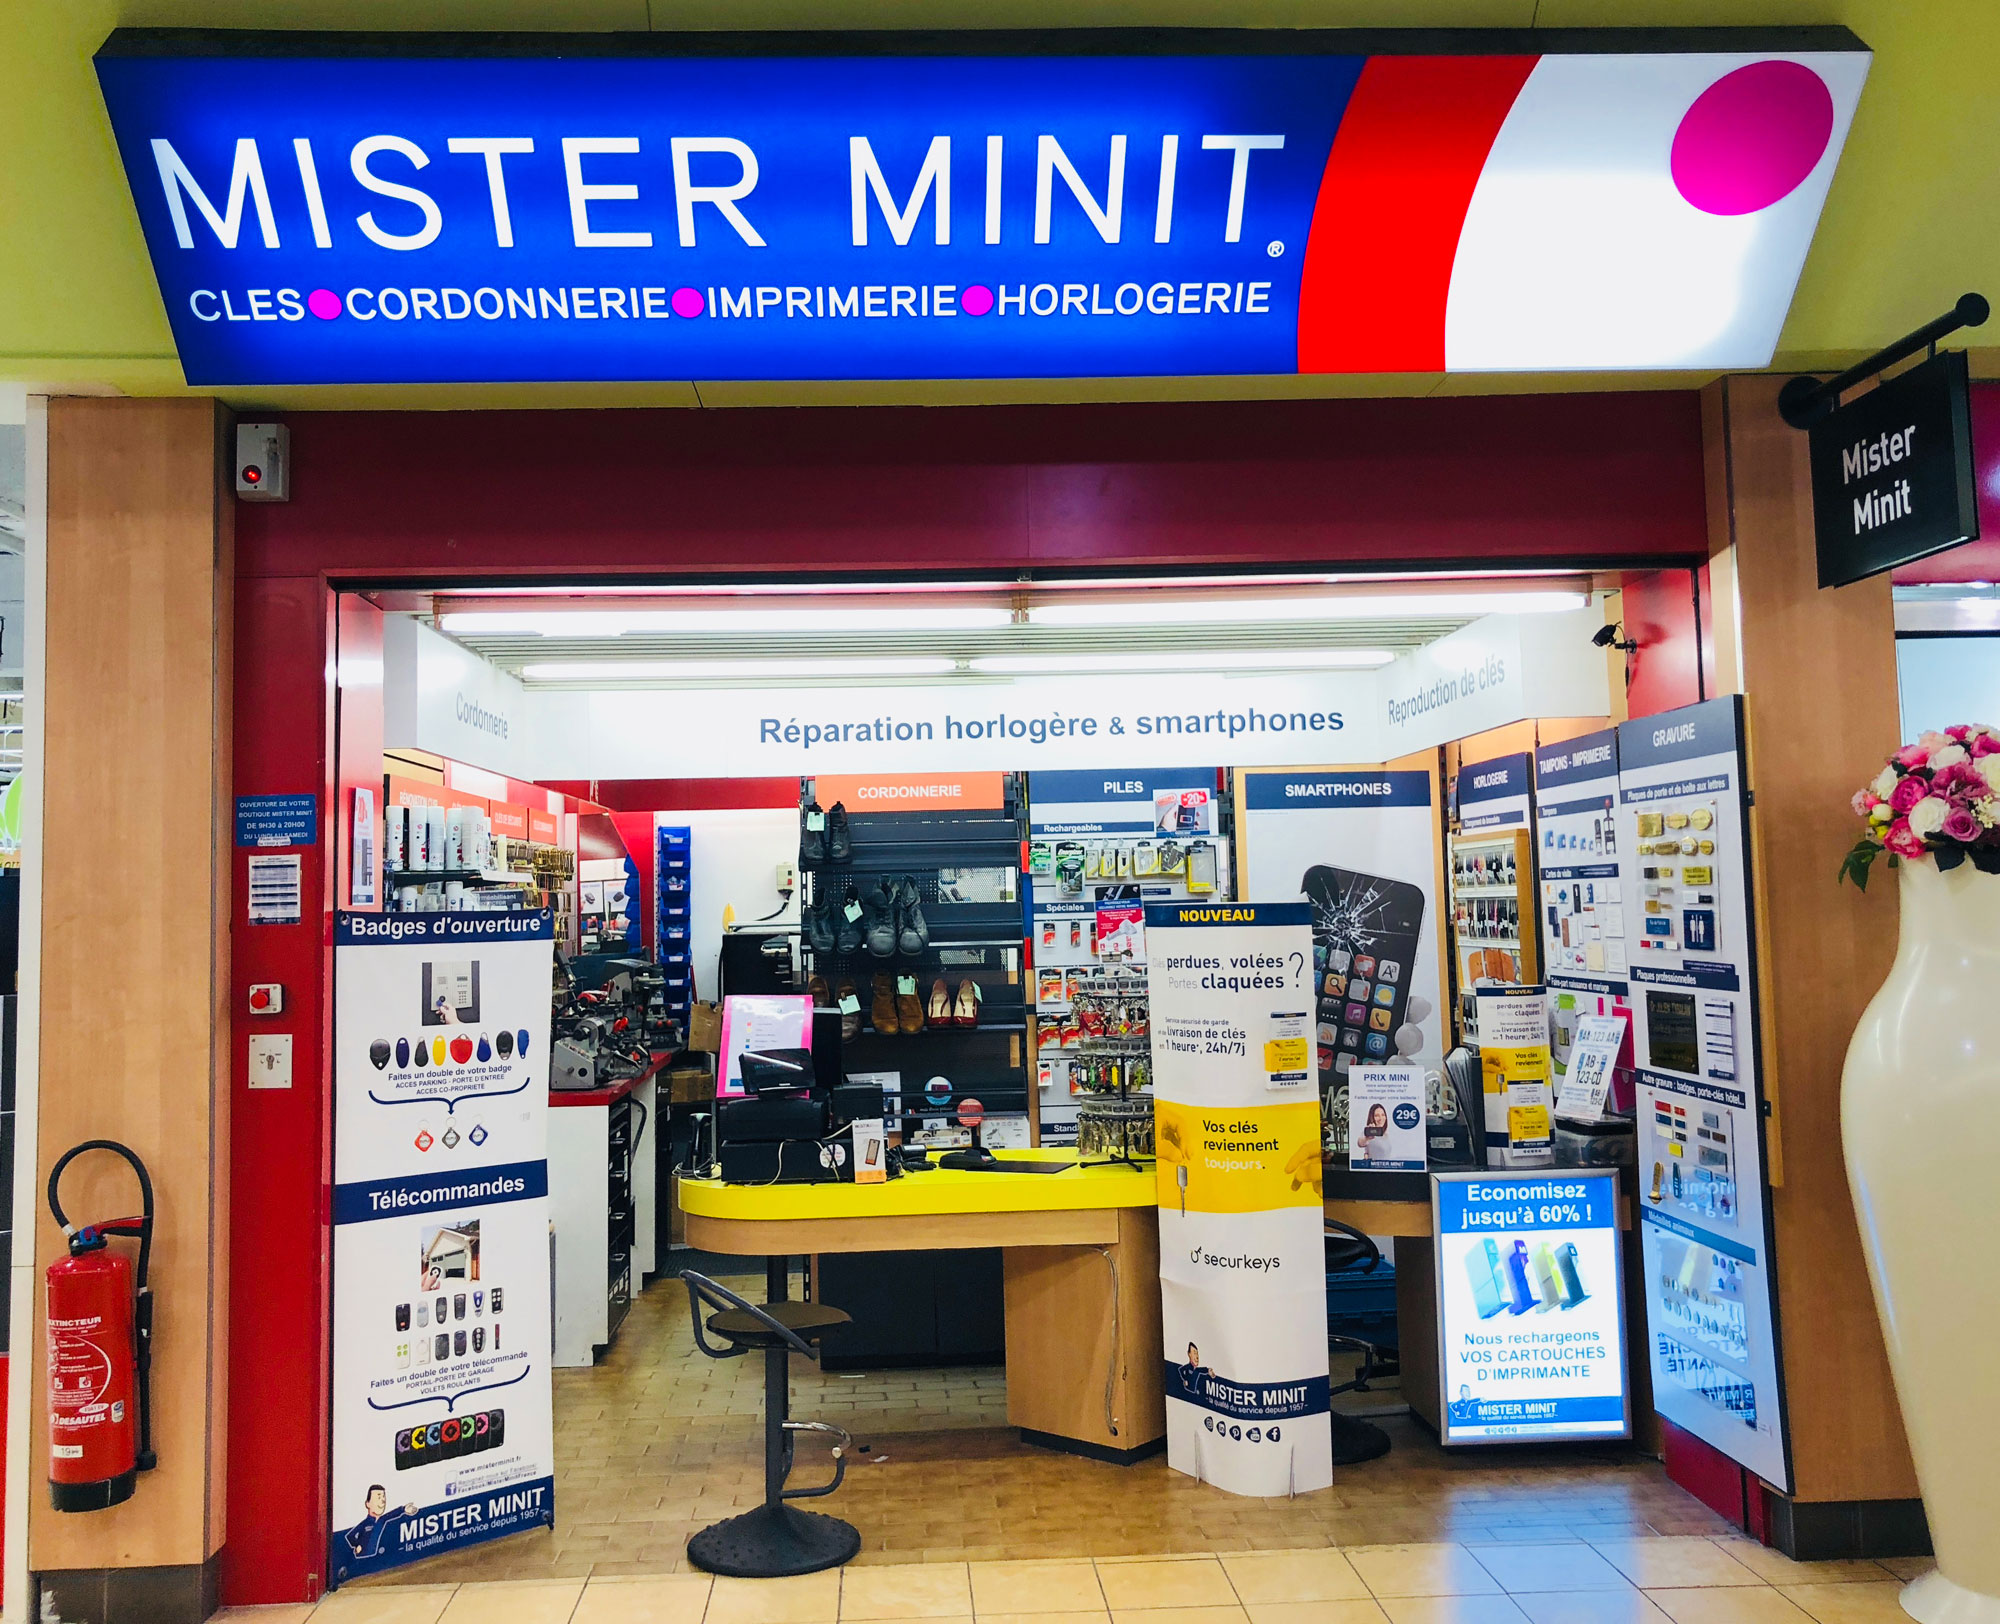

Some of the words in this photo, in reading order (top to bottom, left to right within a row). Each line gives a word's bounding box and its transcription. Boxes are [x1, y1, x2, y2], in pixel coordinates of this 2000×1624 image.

[150, 134, 767, 251] MISTER
[849, 134, 1286, 246] MINIT
[189, 287, 306, 322] CLES
[346, 286, 669, 320] CORDONNERIE
[707, 285, 957, 319] IMPRIMERIE
[998, 281, 1272, 317] HORLOGERIE
[1842, 424, 1916, 485] Mister
[1853, 478, 1912, 536] Minit
[1388, 677, 1457, 728] Reproduction
[1460, 667, 1475, 698] de
[1479, 653, 1505, 690] clés
[456, 690, 508, 740] Cordonnerie
[760, 716, 933, 749] Réparation
[945, 711, 1098, 744] horlogère
[1109, 716, 1125, 735] &
[1136, 707, 1344, 739] smartphones
[1652, 722, 1695, 747] GRAVURE
[1539, 754, 1568, 775] TAMPONS
[1572, 744, 1611, 768] IMPRIMERIE
[1103, 780, 1144, 794] PILES
[1473, 770, 1508, 790] HORLOGERIE
[858, 785, 962, 799] CORDONNERIE
[1285, 782, 1392, 797] SMARTPHONES
[239, 801, 278, 809] OUVERTURE
[1043, 824, 1103, 833] Rechargeables
[1046, 903, 1085, 913] Spéciales
[1179, 908, 1255, 923] NOUVEAU
[351, 917, 426, 939] Badges
[432, 916, 541, 935] d'ouverture
[1166, 955, 1224, 971] perdues,
[1230, 953, 1284, 968] volées
[1168, 976, 1198, 989] Portes
[1201, 971, 1285, 993] claquées
[1211, 1018, 1229, 1026] garde
[1167, 1026, 1202, 1039] livraison
[1205, 1028, 1218, 1039] de
[1221, 1027, 1246, 1039] clés
[1205, 1042, 1246, 1056] 24h/7j
[388, 1072, 412, 1081] Faites
[426, 1068, 454, 1078] double
[455, 1067, 465, 1076] de
[467, 1066, 486, 1075] votre
[488, 1064, 512, 1074] badge
[418, 1078, 447, 1087] PARKING
[452, 1076, 473, 1084] PORTE
[1363, 1073, 1386, 1082] PRIX
[1389, 1073, 1410, 1082] MINI
[1396, 1109, 1417, 1120] 29€
[1203, 1120, 1225, 1134] Vos
[1228, 1120, 1258, 1134] clés
[1203, 1138, 1279, 1152] reviennent
[368, 1175, 525, 1212] Télécommandes
[1467, 1182, 1587, 1202] Economisez
[1461, 1205, 1535, 1230] jusqu'à
[1539, 1205, 1581, 1224] 60%
[1204, 1253, 1281, 1273] securkeys
[1464, 1332, 1503, 1346] Nous
[1507, 1330, 1600, 1346] rechargeons
[1460, 1350, 1493, 1364] VOS
[1497, 1346, 1606, 1363] CARTOUCHES
[370, 1378, 395, 1389] Faites
[409, 1369, 437, 1381] double
[438, 1367, 449, 1375] de
[450, 1363, 470, 1372] votre
[472, 1350, 528, 1368] télécommande
[457, 1372, 466, 1380] DE
[467, 1366, 495, 1377] GARAGE
[1477, 1364, 1591, 1381] D'IMPRIMANTE
[420, 1384, 446, 1395] VOLETS
[446, 1377, 481, 1390] ROULANTS
[1205, 1379, 1258, 1407] MISTER
[1262, 1386, 1308, 1406] MINIT
[1230, 1404, 1237, 1412] du
[1238, 1406, 1264, 1414] service
[1264, 1404, 1288, 1415] depuis
[1289, 1402, 1304, 1412] 1957
[1477, 1403, 1523, 1416] MISTER
[1525, 1402, 1558, 1414] MINIT
[59, 1412, 106, 1426] DESAUTEL
[399, 1503, 482, 1543] MISTER
[488, 1487, 545, 1519] MINIT
[405, 1542, 413, 1552] la
[415, 1534, 445, 1551] qualité
[446, 1530, 457, 1540] du
[459, 1523, 489, 1536] service
[490, 1515, 518, 1529] depuis
[520, 1507, 540, 1521] 1957
